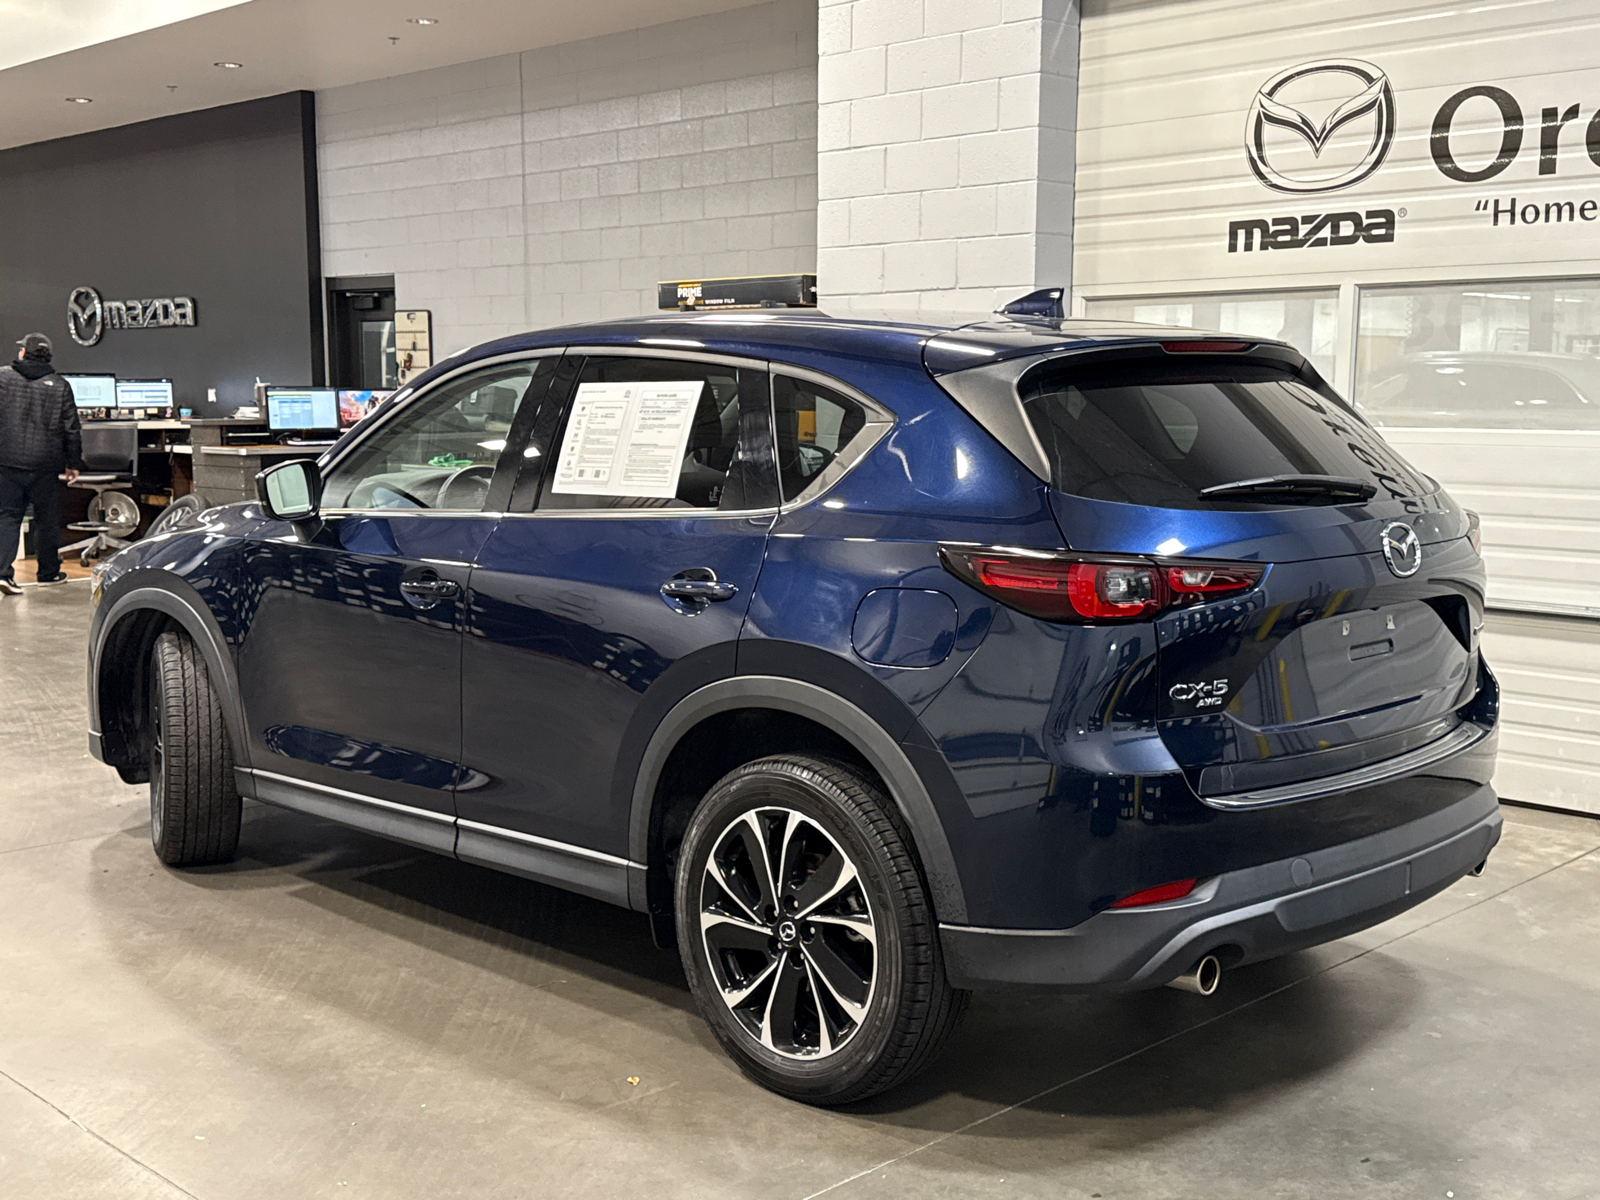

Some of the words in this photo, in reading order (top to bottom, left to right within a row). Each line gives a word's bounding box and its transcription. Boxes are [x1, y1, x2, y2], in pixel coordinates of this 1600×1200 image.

[1430, 85, 1600, 183] Or
[677, 286, 702, 298] PRIME
[1169, 679, 1229, 700] CX-5
[1196, 697, 1222, 708] AWD
